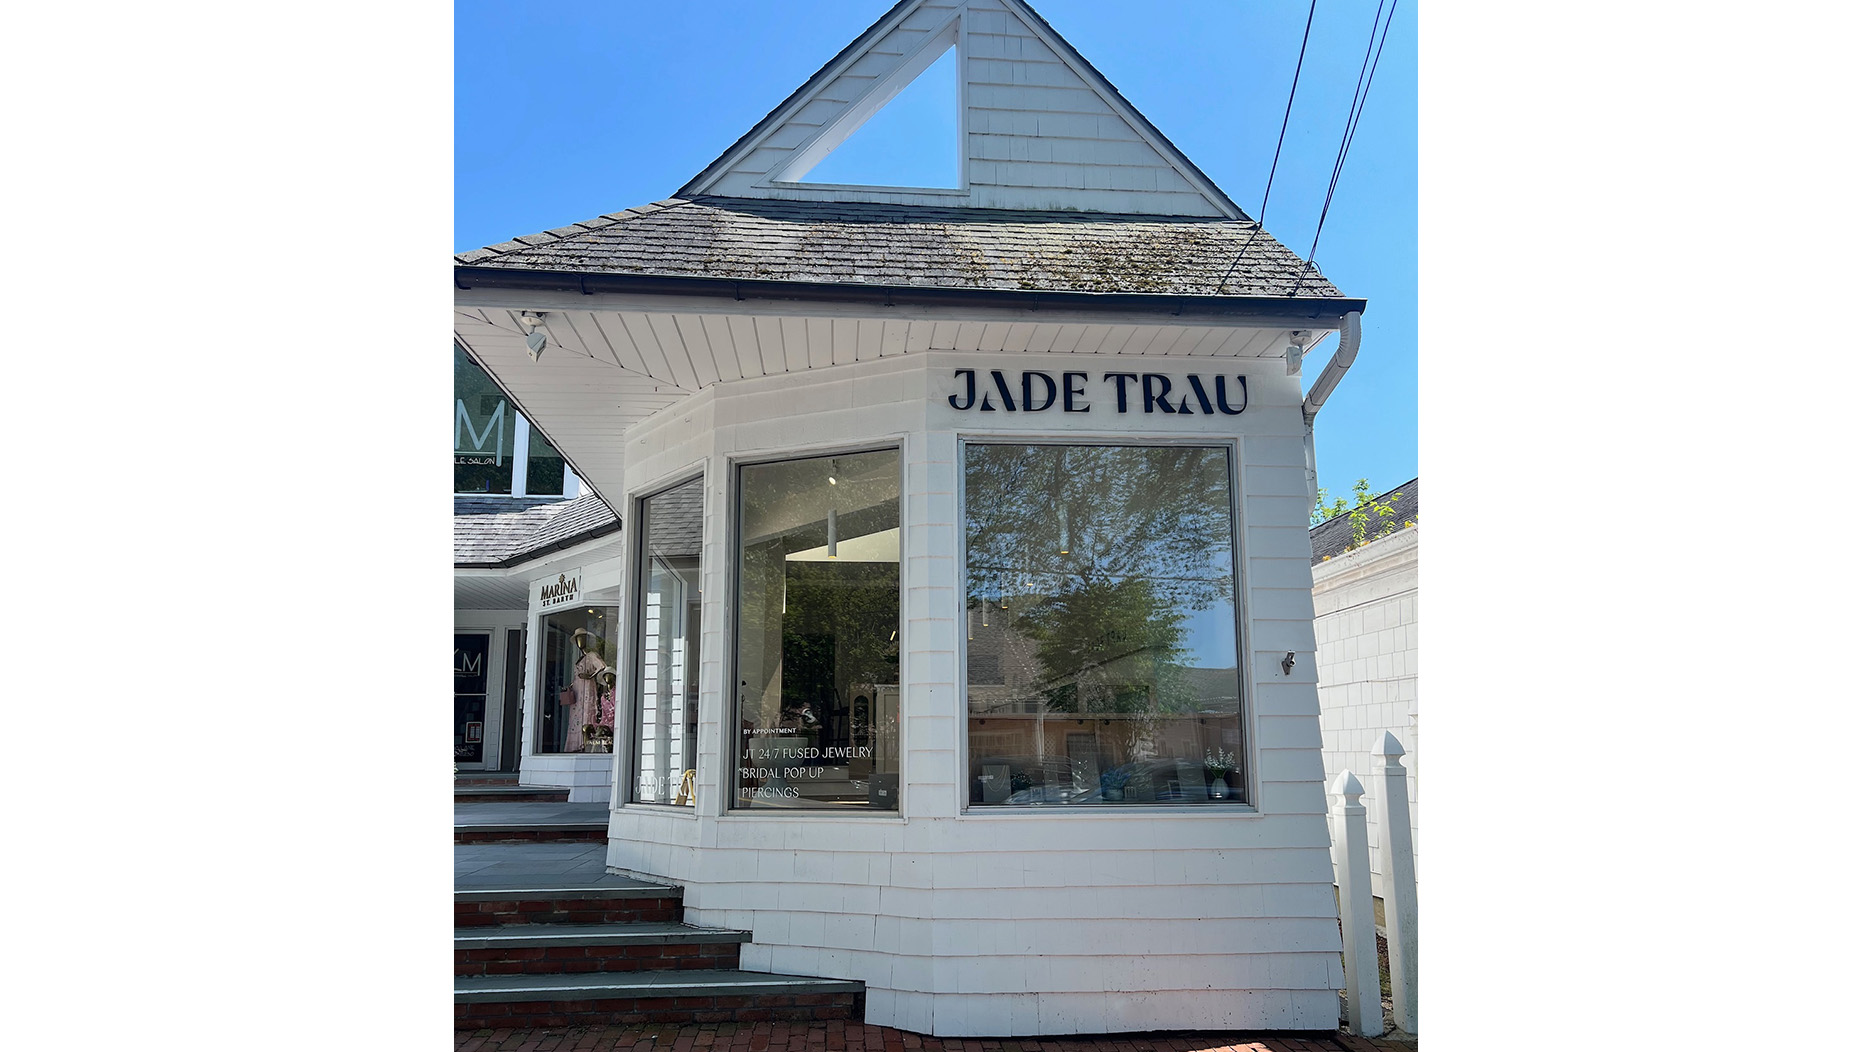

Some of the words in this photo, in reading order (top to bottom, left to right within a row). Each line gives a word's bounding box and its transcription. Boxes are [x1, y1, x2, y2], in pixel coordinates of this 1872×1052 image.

[948, 369, 1091, 413] JADE
[1103, 372, 1248, 415] TRAU
[540, 577, 578, 600] MARINA
[552, 594, 574, 605] BARTH
[752, 727, 797, 735] APPOINTMENT
[742, 748, 756, 760] JT
[758, 748, 779, 760] 24/7
[783, 747, 819, 759] FUSED
[821, 746, 873, 759] JEWELRY
[783, 767, 806, 778] POP
[808, 766, 824, 778] UP
[742, 786, 799, 798] PIERCINGS
